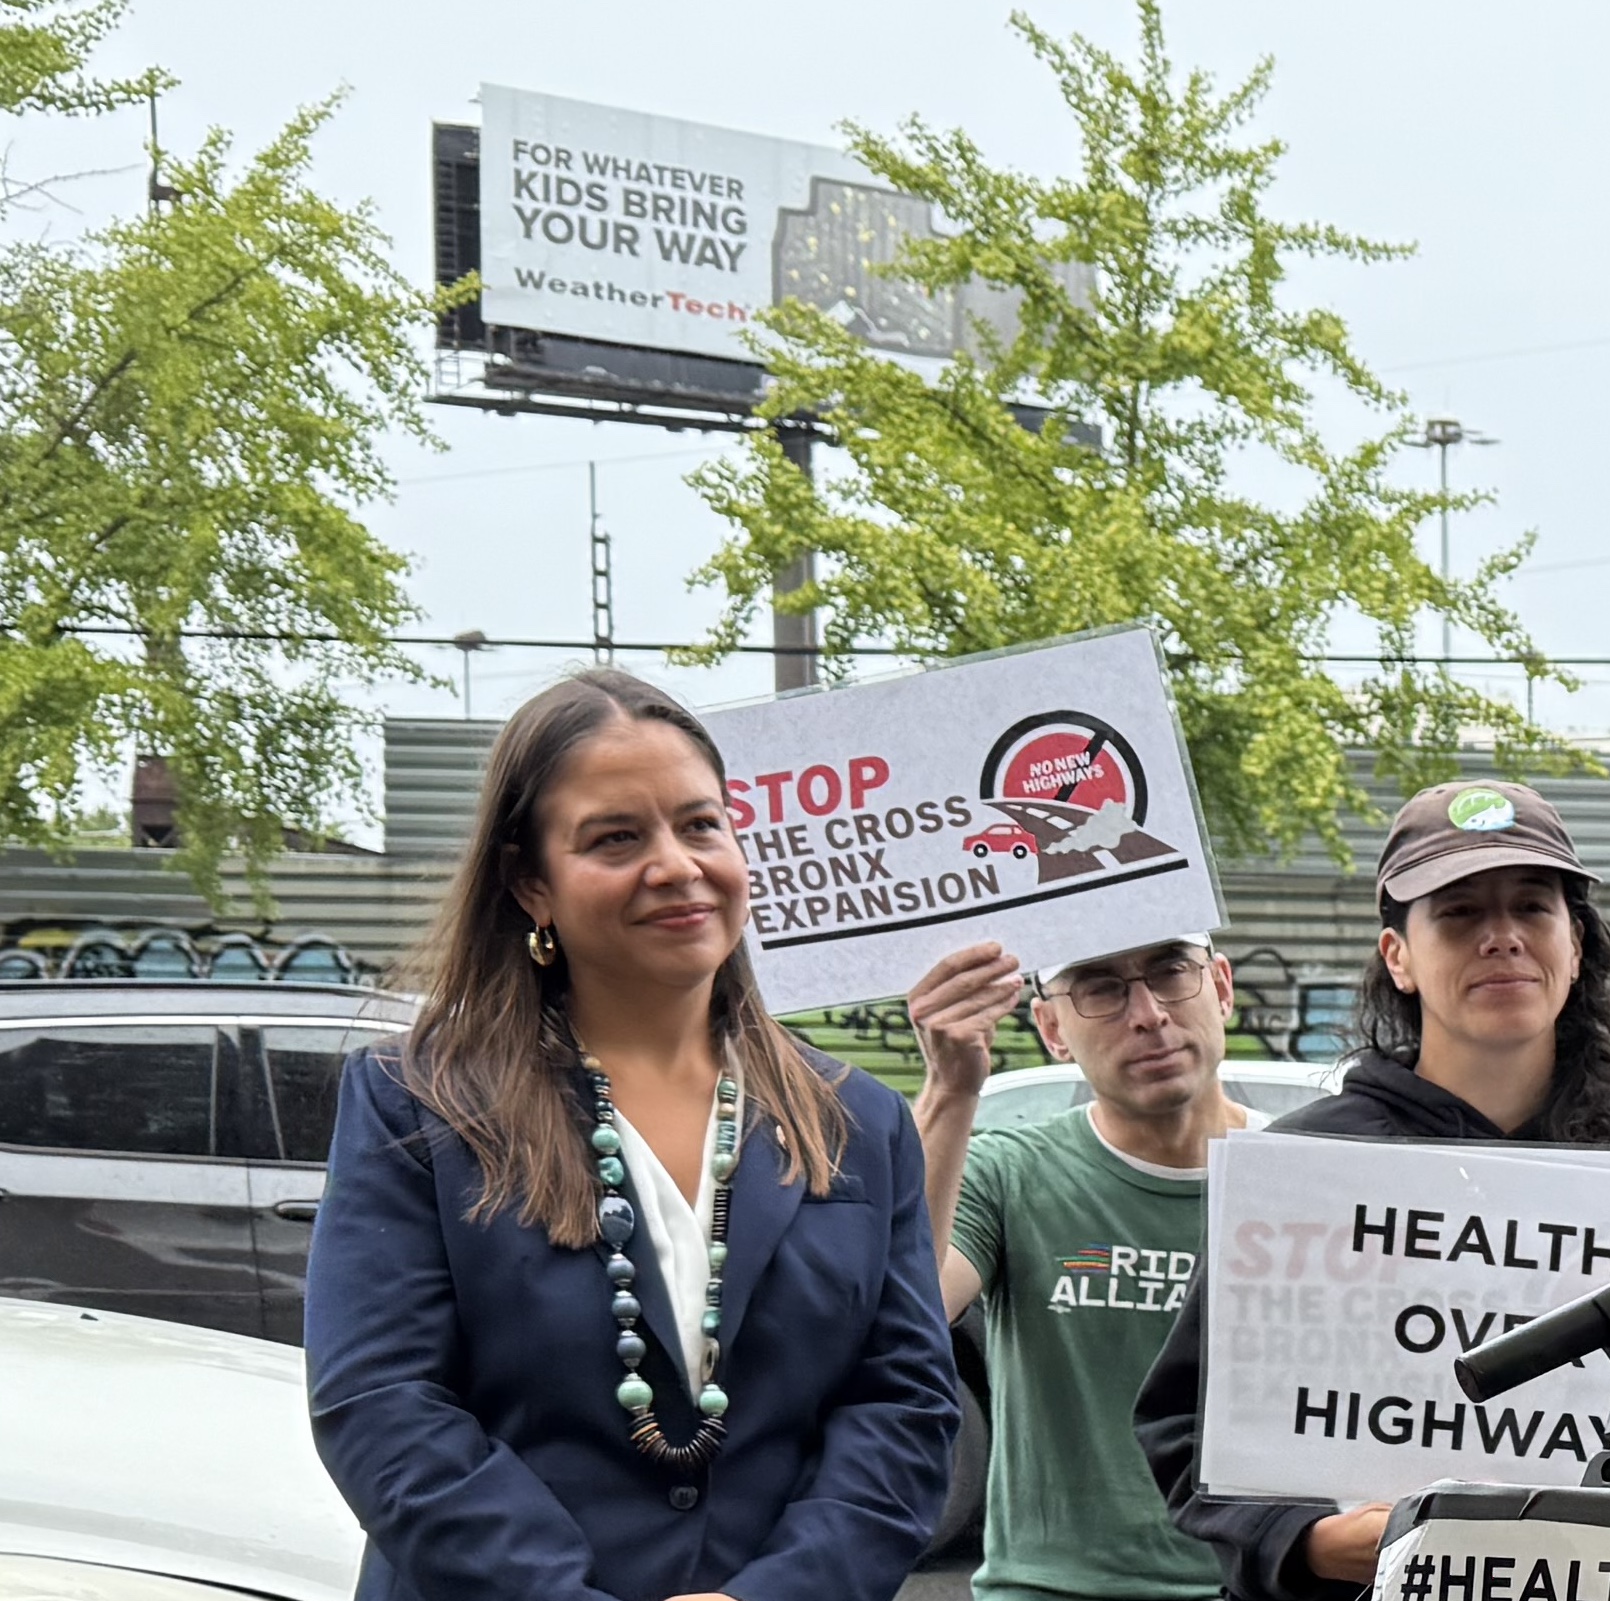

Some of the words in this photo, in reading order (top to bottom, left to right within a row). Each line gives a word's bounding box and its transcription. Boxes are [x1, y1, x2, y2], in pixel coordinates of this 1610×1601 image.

[512, 139, 573, 171] FOR
[582, 151, 744, 200] WHATEVER
[513, 168, 609, 212] KIDS
[622, 188, 747, 235] BRING
[511, 204, 640, 257] YOUR
[654, 228, 747, 273] WAY
[514, 267, 748, 322] WeatherTech
[726, 756, 889, 829] STOP
[1022, 764, 1104, 794] HIGHWAYS
[1030, 760, 1053, 777] NO
[1054, 751, 1090, 771] NEW
[736, 824, 814, 864] THE
[825, 796, 972, 850] CROSS
[749, 847, 893, 899] BRONX
[750, 864, 1000, 934] EXPANSION
[1110, 1245, 1196, 1280] RID
[1050, 1275, 1187, 1312] ALLIA
[1295, 1386, 1610, 1462] HIGHWA
